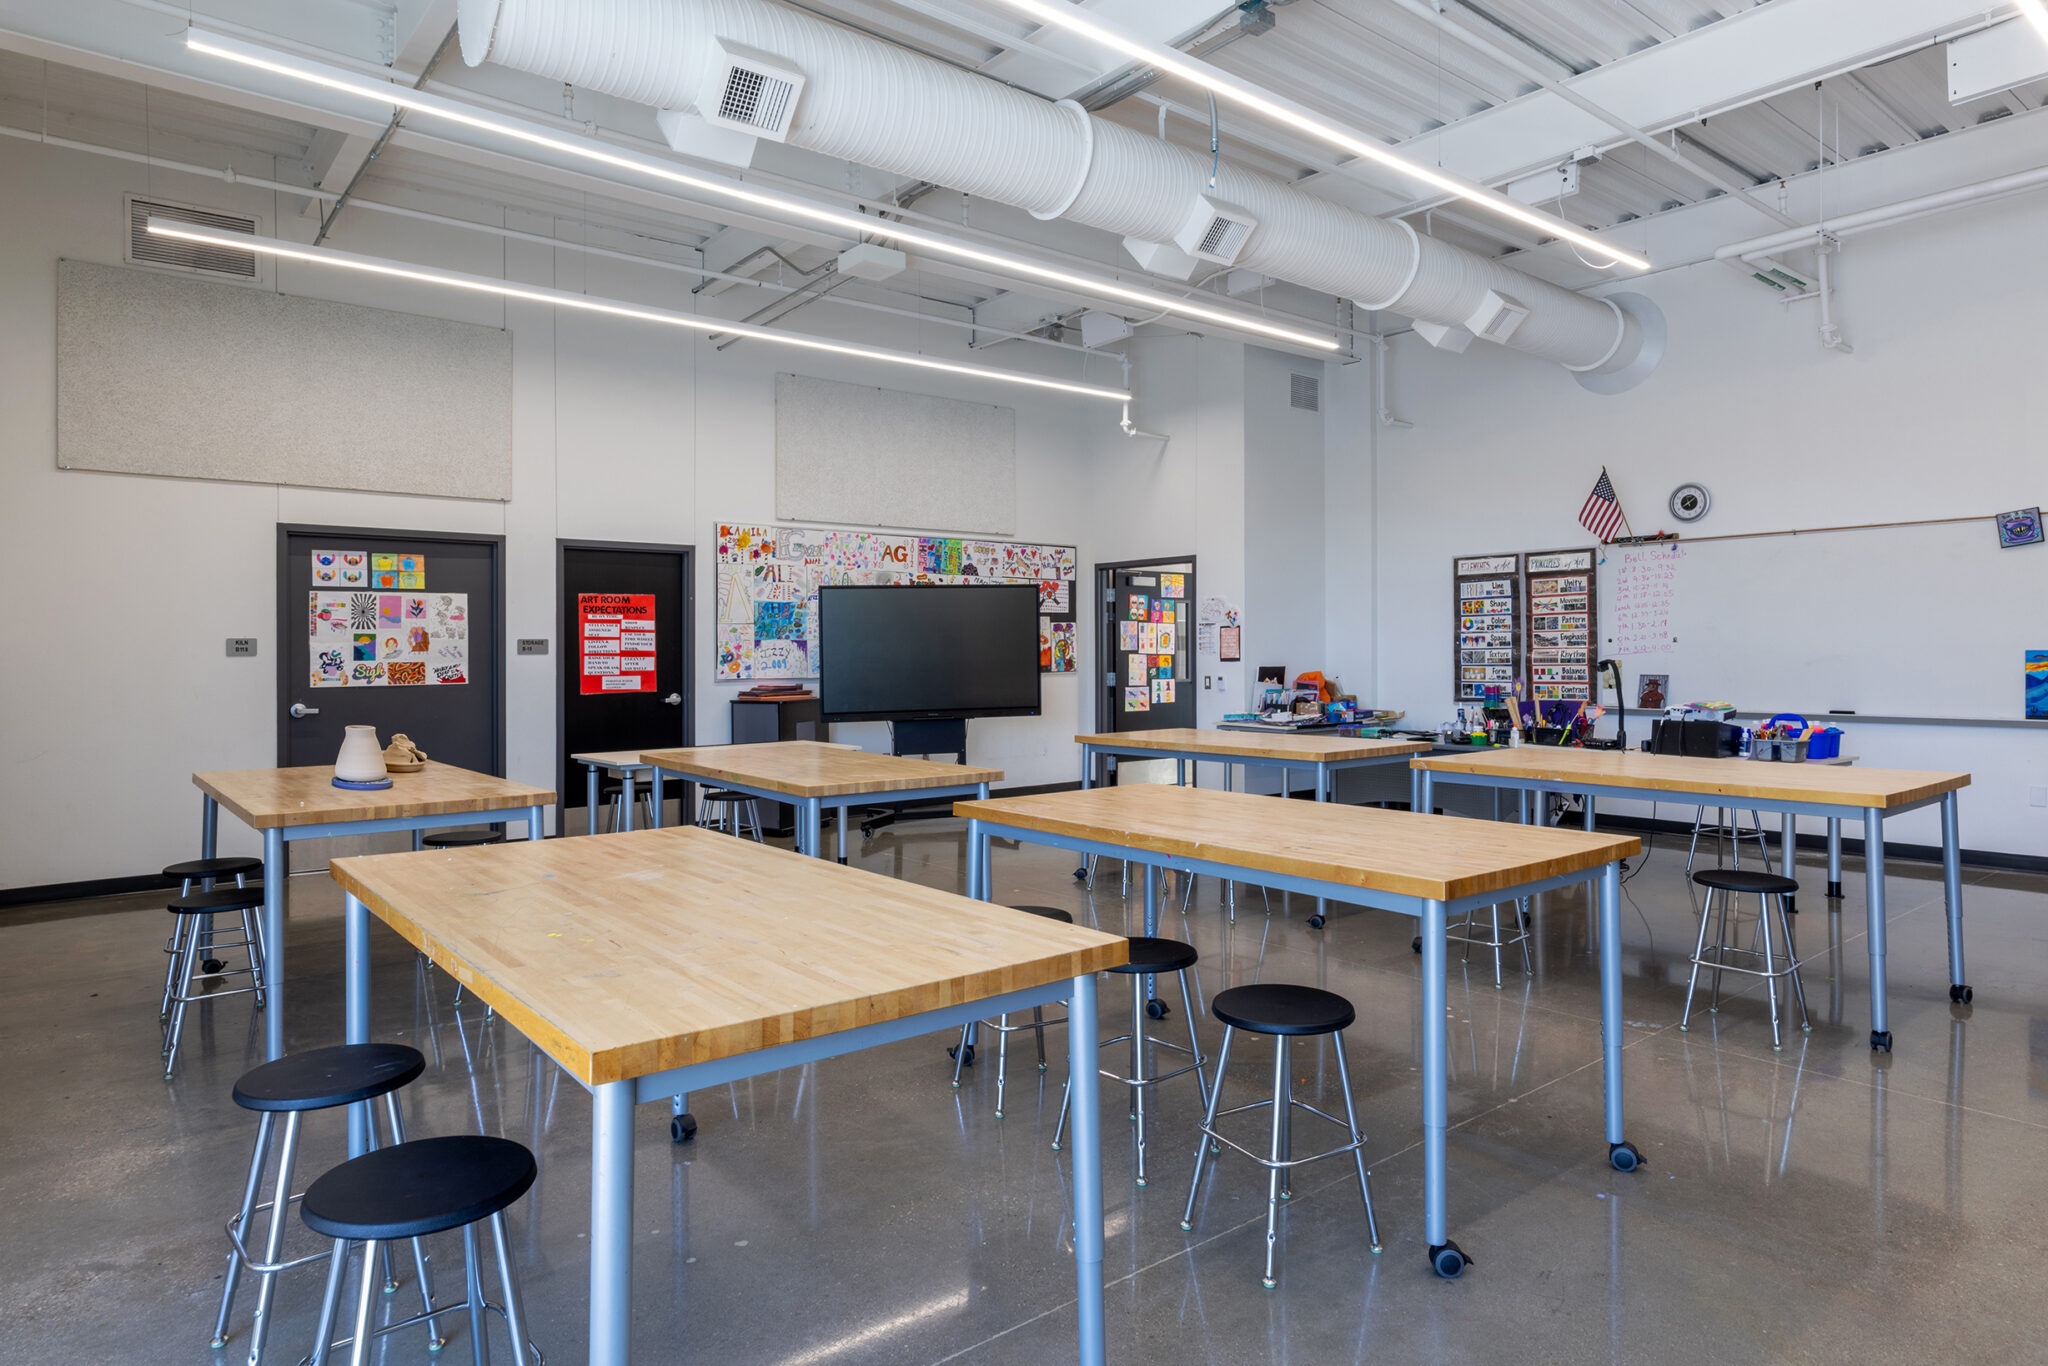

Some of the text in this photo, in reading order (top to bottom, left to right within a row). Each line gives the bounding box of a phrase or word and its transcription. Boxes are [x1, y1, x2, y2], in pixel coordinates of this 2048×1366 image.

[881, 545, 908, 563] AG
[1625, 552, 1645, 563] Bell
[1492, 582, 1504, 590] Line
[1564, 579, 1582, 588] Unity
[581, 596, 631, 604] ART ROOM
[1490, 601, 1507, 609] Shape
[583, 606, 647, 614] EXPECTATIONS
[1490, 634, 1507, 642] Space
[1560, 632, 1587, 641] Emphasis
[1489, 650, 1509, 658] Texture
[1560, 650, 1586, 658] Rhythm
[352, 662, 386, 684] Sigh
